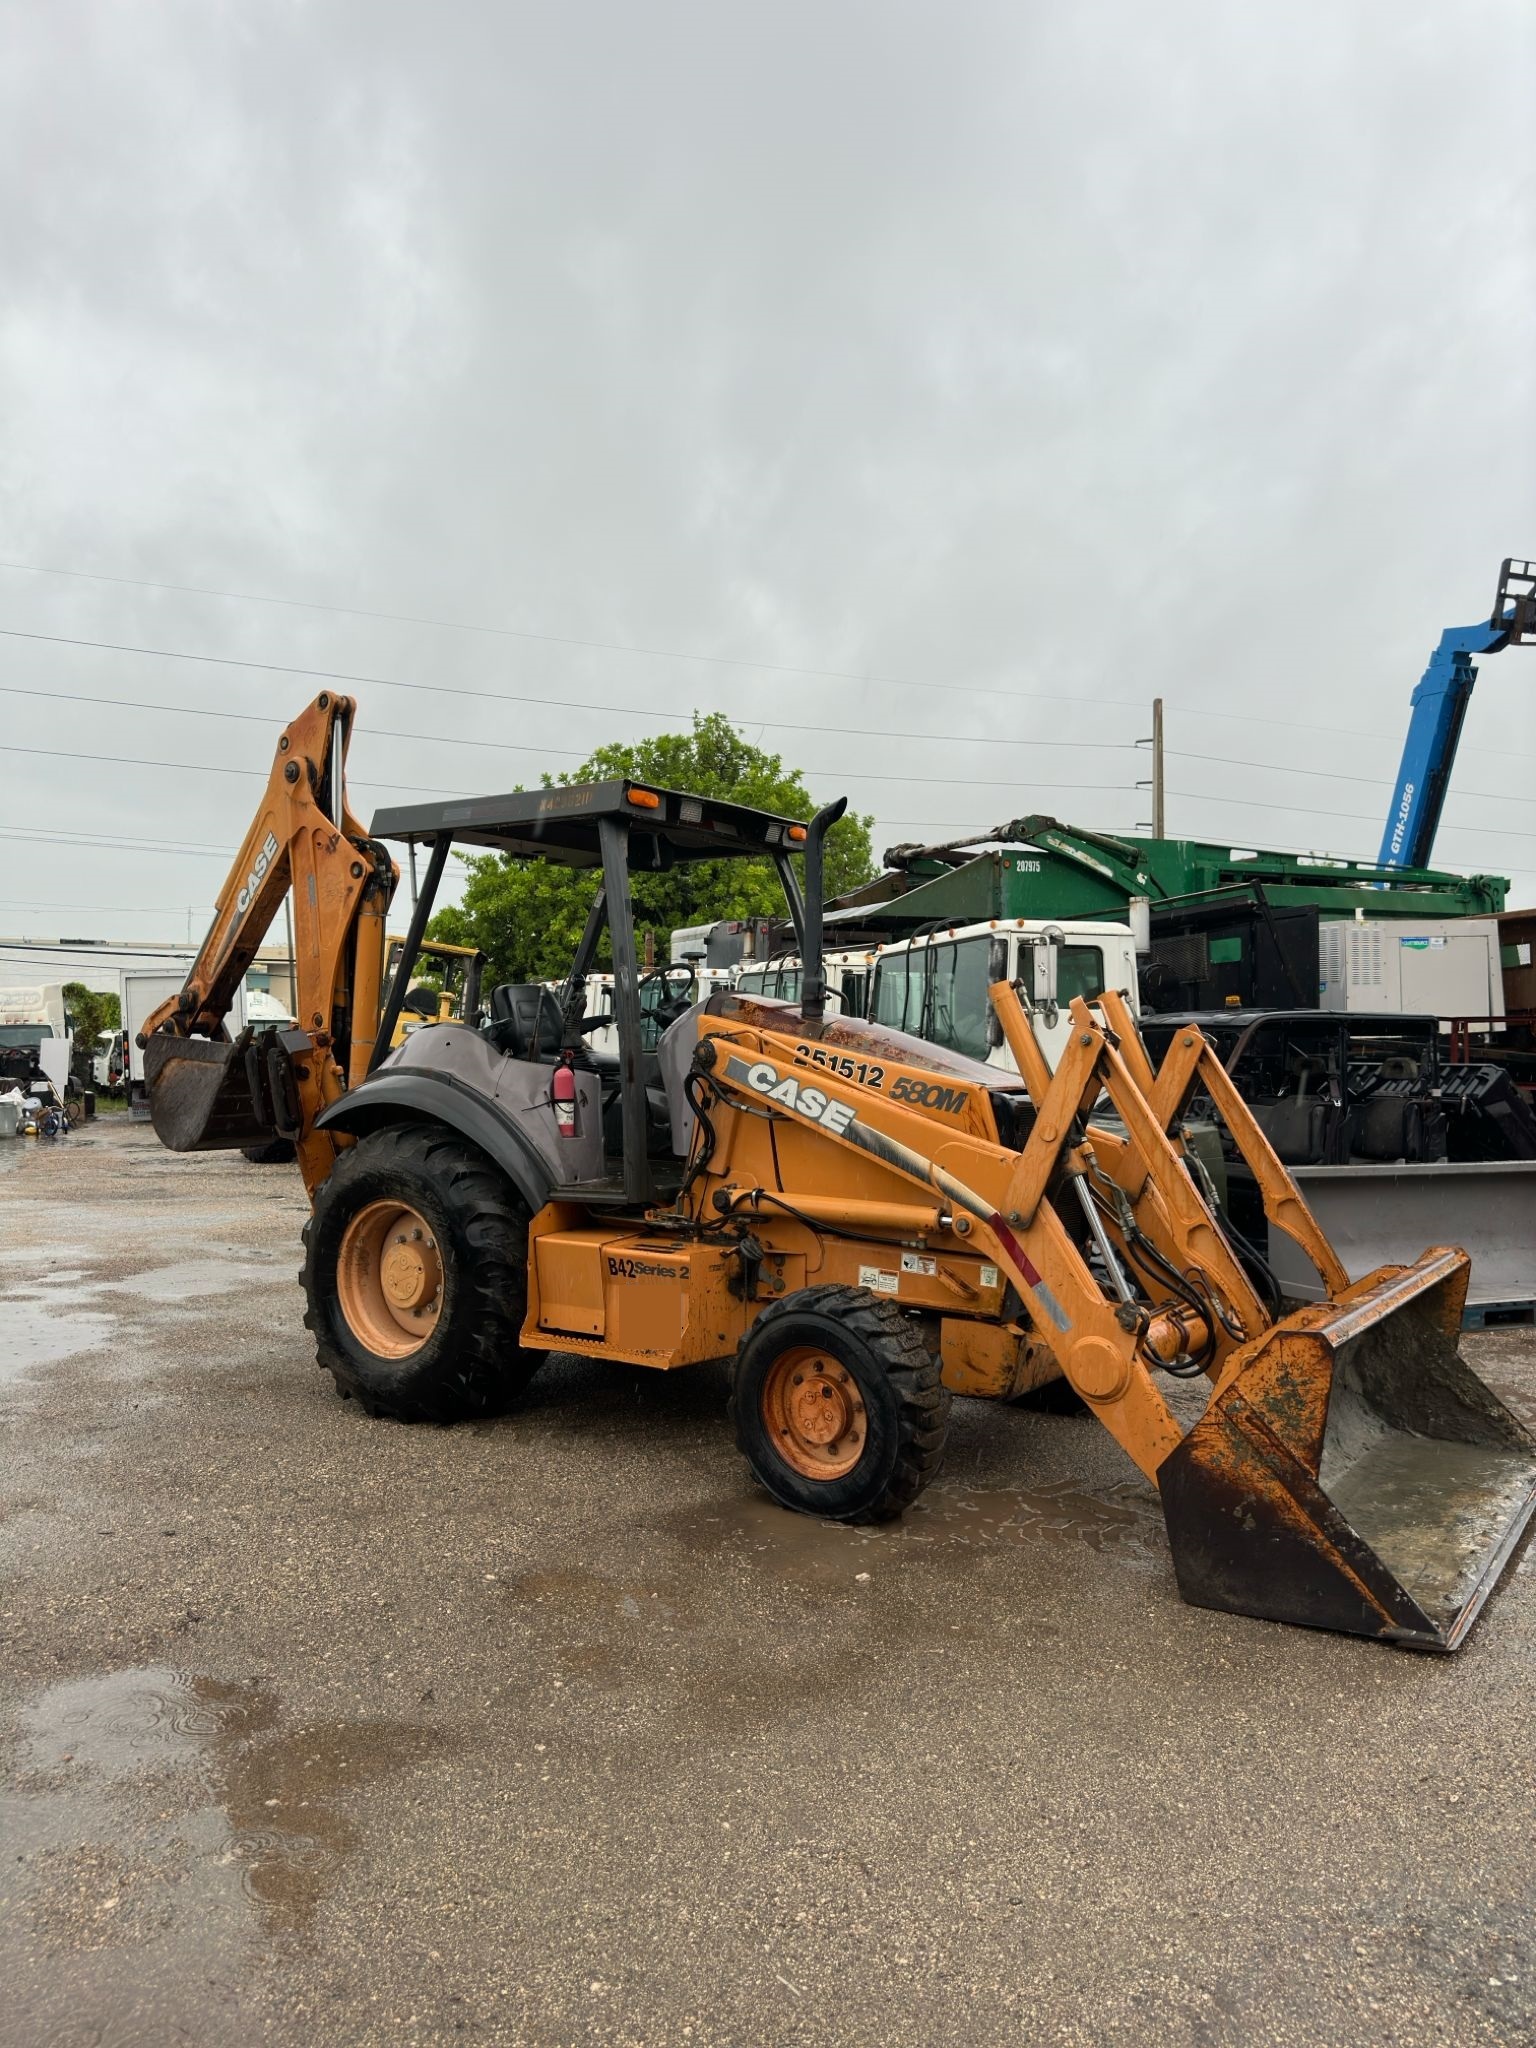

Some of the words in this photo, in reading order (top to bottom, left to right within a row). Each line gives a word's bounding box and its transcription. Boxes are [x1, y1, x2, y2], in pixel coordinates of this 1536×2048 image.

[1391, 783, 1414, 854] GTH-1056
[237, 831, 278, 913] CASE
[1016, 860, 1041, 872] 207975
[793, 1044, 885, 1089] 251512
[747, 1063, 856, 1135] CASE
[889, 1077, 969, 1114] 580M
[608, 1257, 636, 1279] B42
[634, 1261, 676, 1278] Series
[679, 1266, 690, 1279] 2
